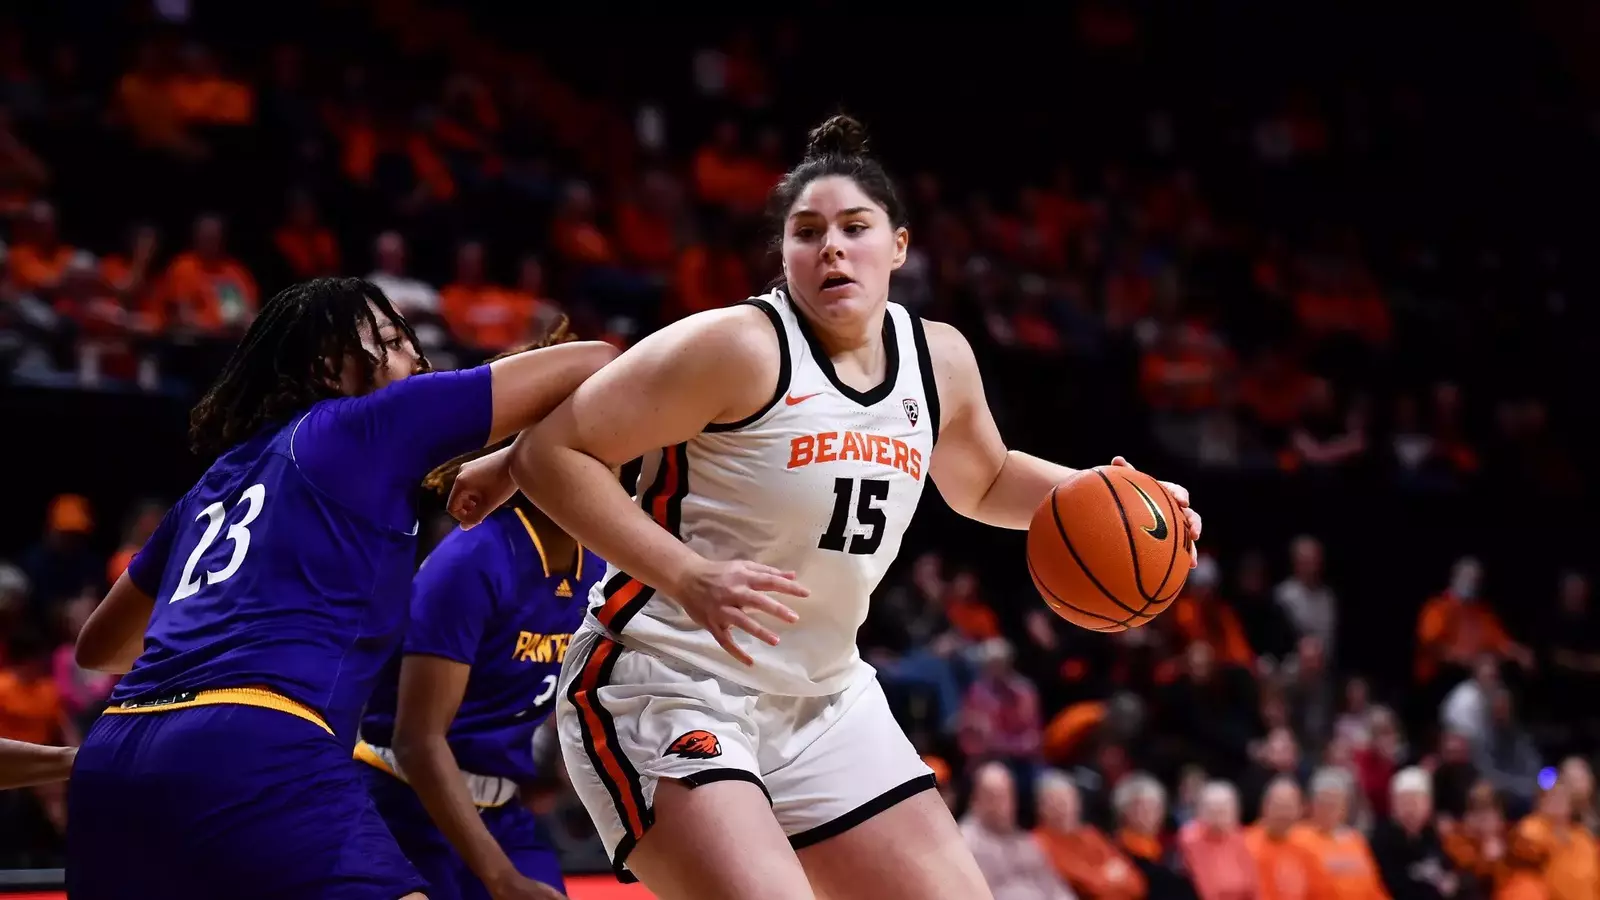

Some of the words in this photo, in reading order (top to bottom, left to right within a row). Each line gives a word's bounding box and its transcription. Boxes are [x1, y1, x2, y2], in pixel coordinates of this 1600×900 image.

[787, 431, 922, 481] BEAVERS
[168, 483, 266, 604] 23
[818, 477, 890, 555] 15
